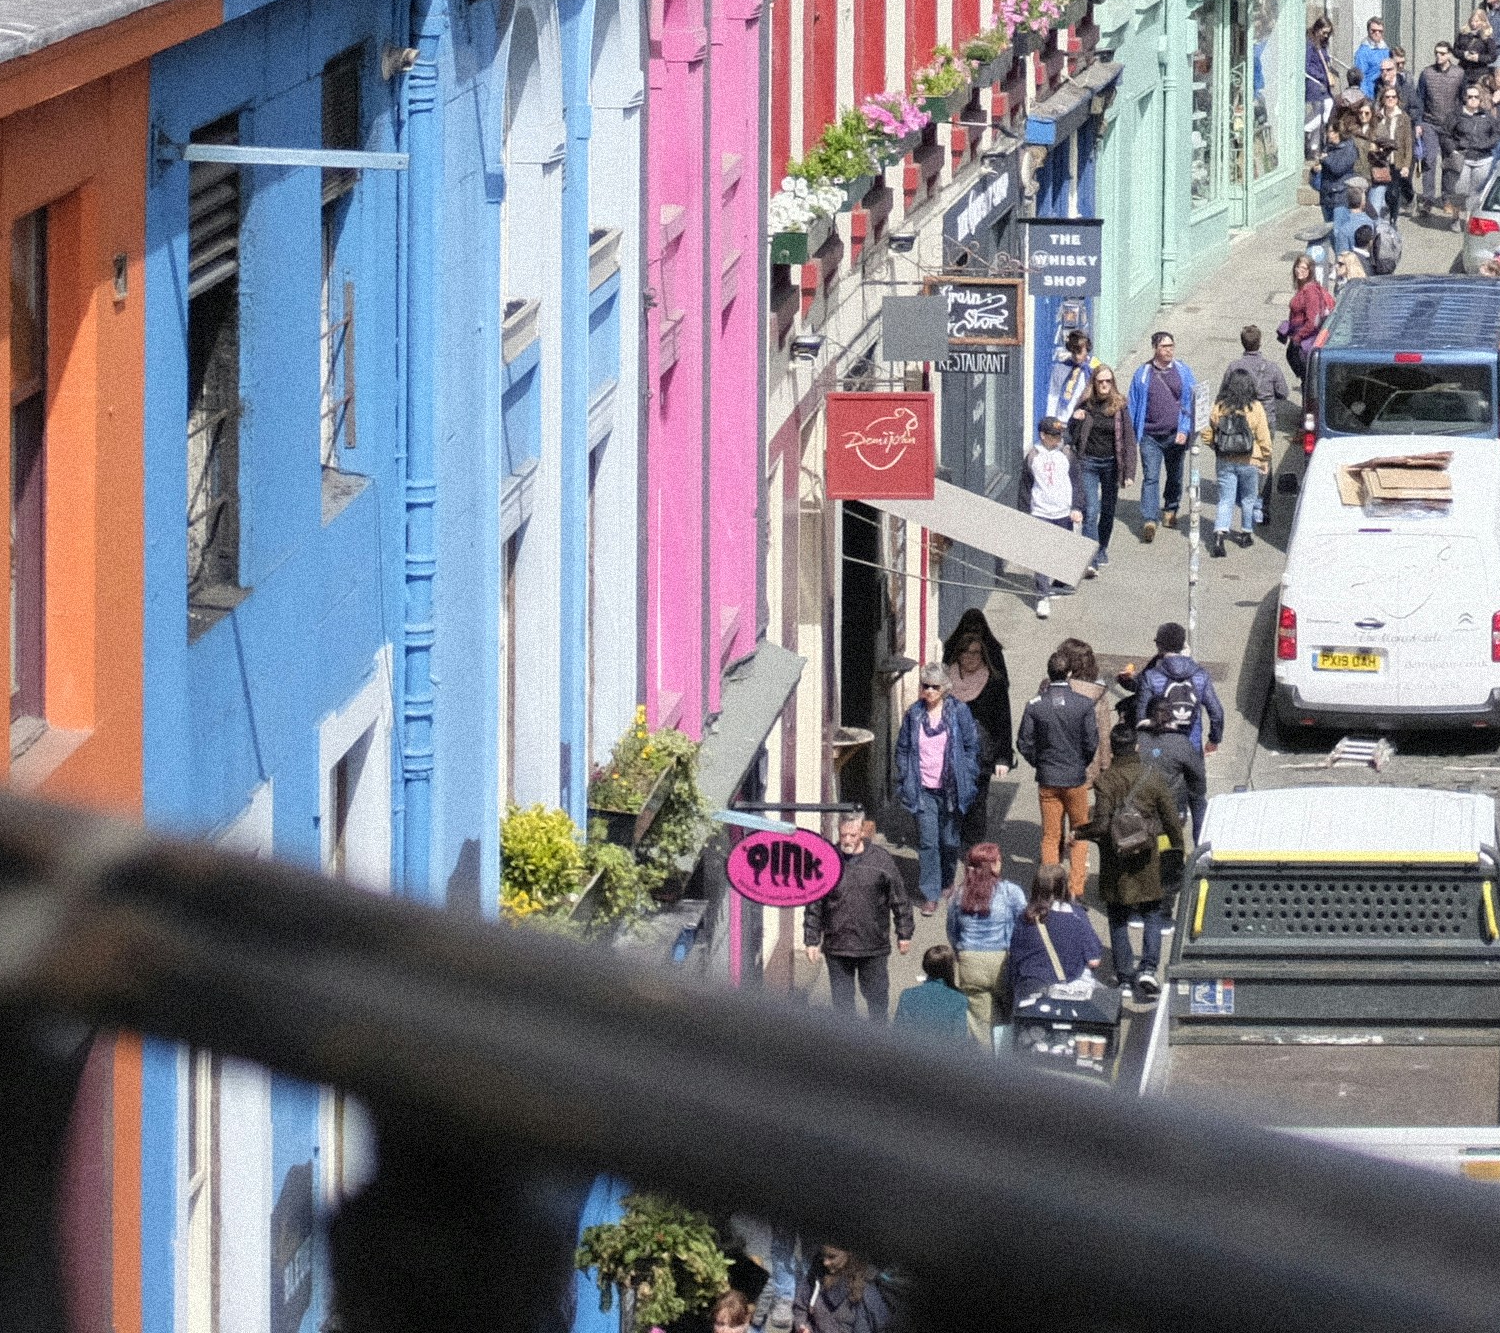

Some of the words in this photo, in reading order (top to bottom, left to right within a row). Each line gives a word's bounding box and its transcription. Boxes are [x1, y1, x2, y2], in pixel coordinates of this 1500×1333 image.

[1049, 234, 1082, 246] THE
[1033, 254, 1098, 266] WHISKY
[1043, 275, 1087, 287] SHOP
[842, 430, 916, 454] Demijohn
[1321, 653, 1349, 667] PX19
